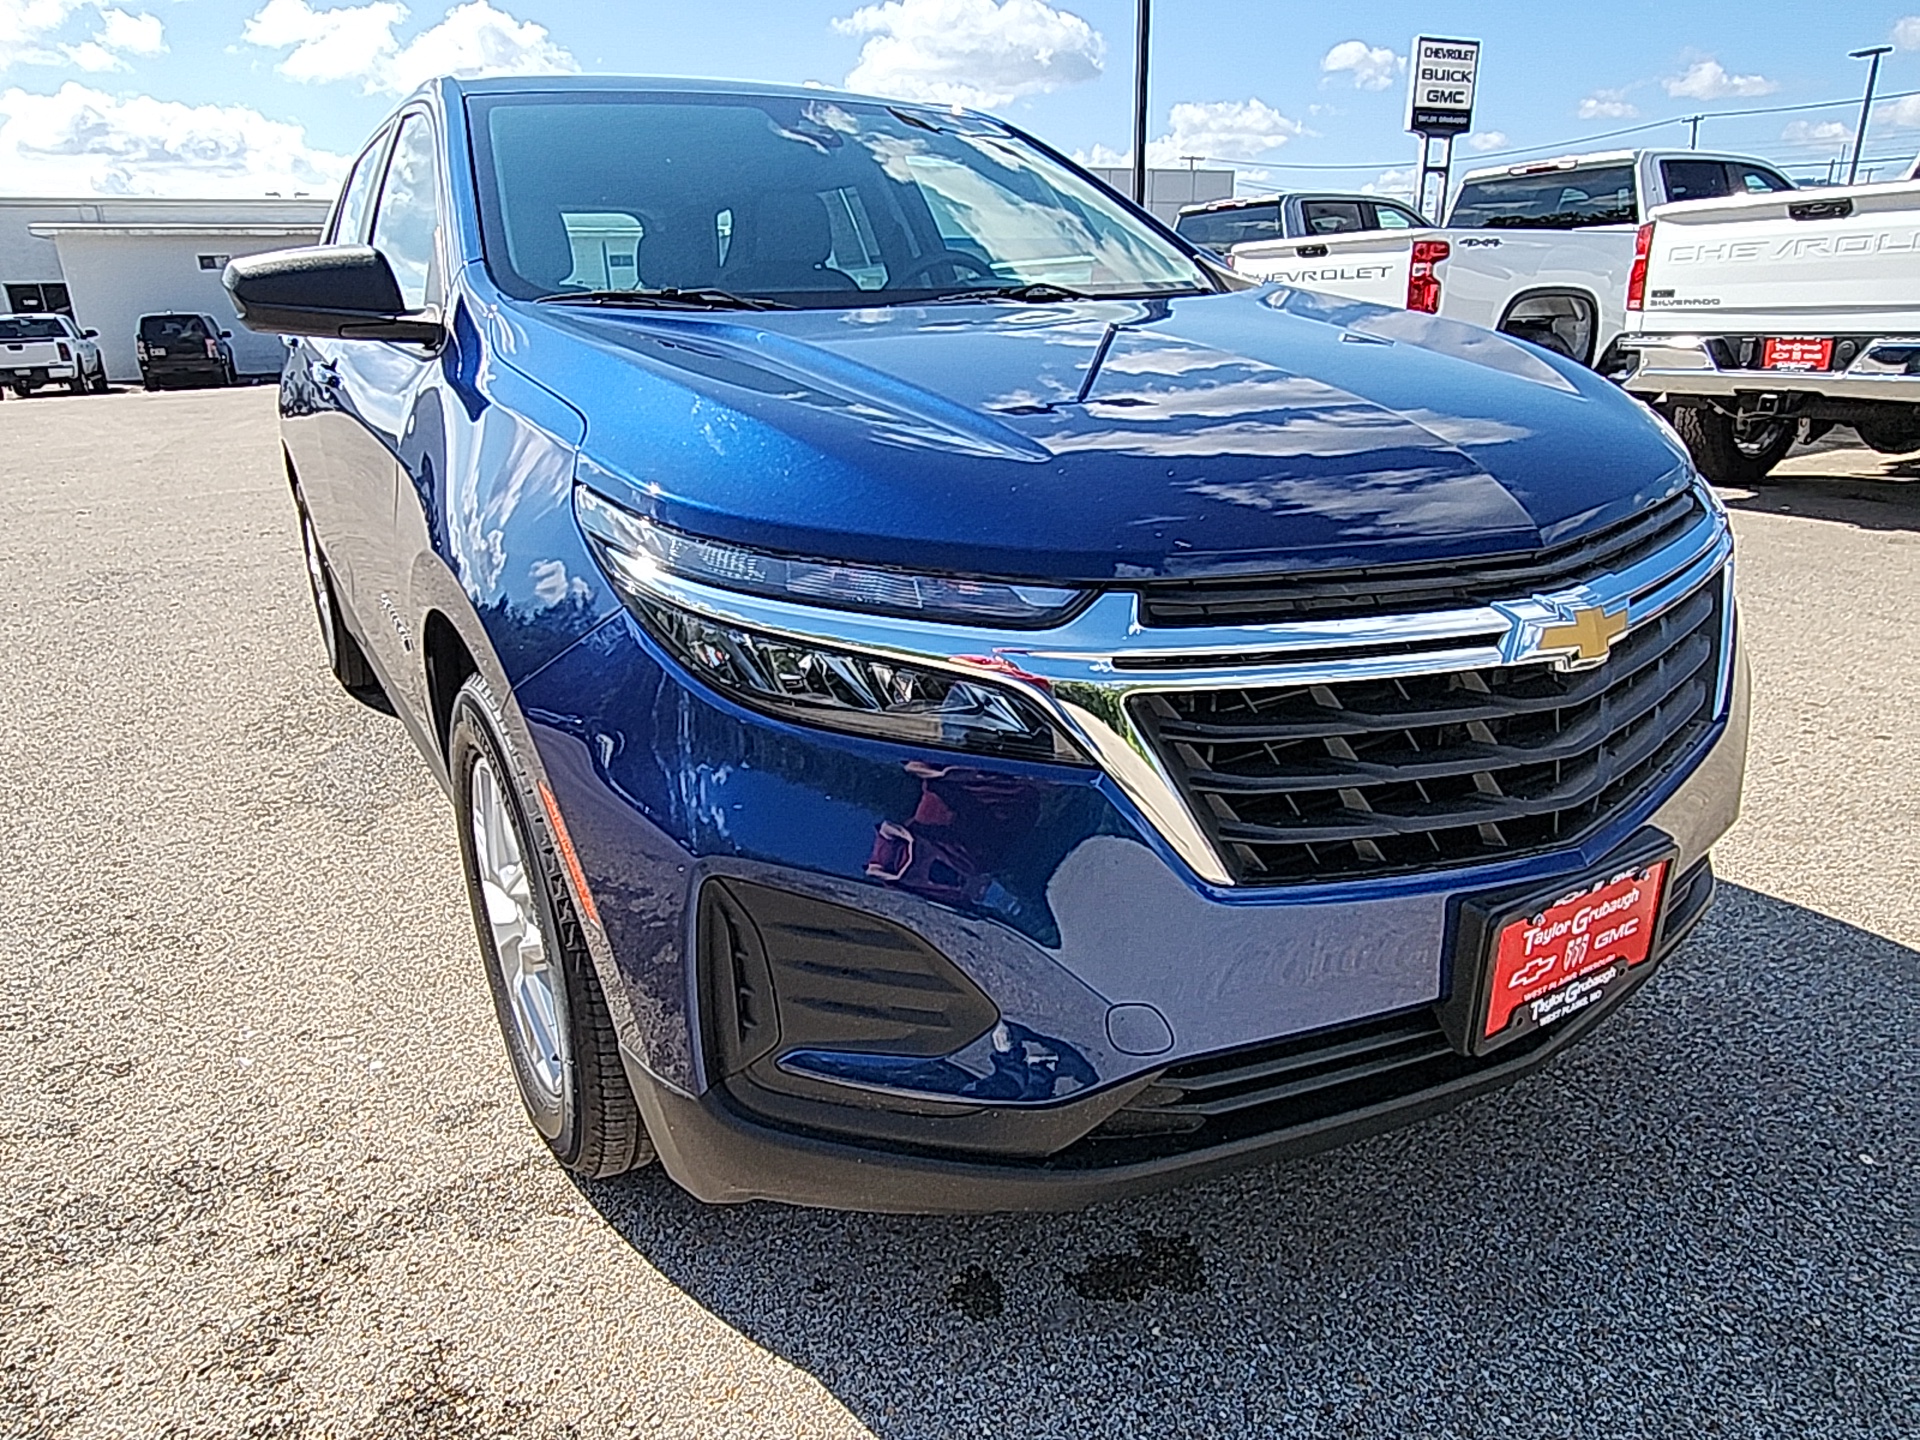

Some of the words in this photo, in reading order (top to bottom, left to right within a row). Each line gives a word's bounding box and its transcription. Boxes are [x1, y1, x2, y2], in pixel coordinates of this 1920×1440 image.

[1424, 47, 1475, 61] CHEVROLET
[1422, 68, 1472, 83] BUICK
[1426, 89, 1465, 104] GMC
[1650, 298, 1721, 307] SILVERADO
[1523, 920, 1572, 956] Taylor
[1571, 887, 1640, 935] Grubaugh
[1594, 917, 1640, 950] GMC
[1530, 992, 1566, 1021] Taylor
